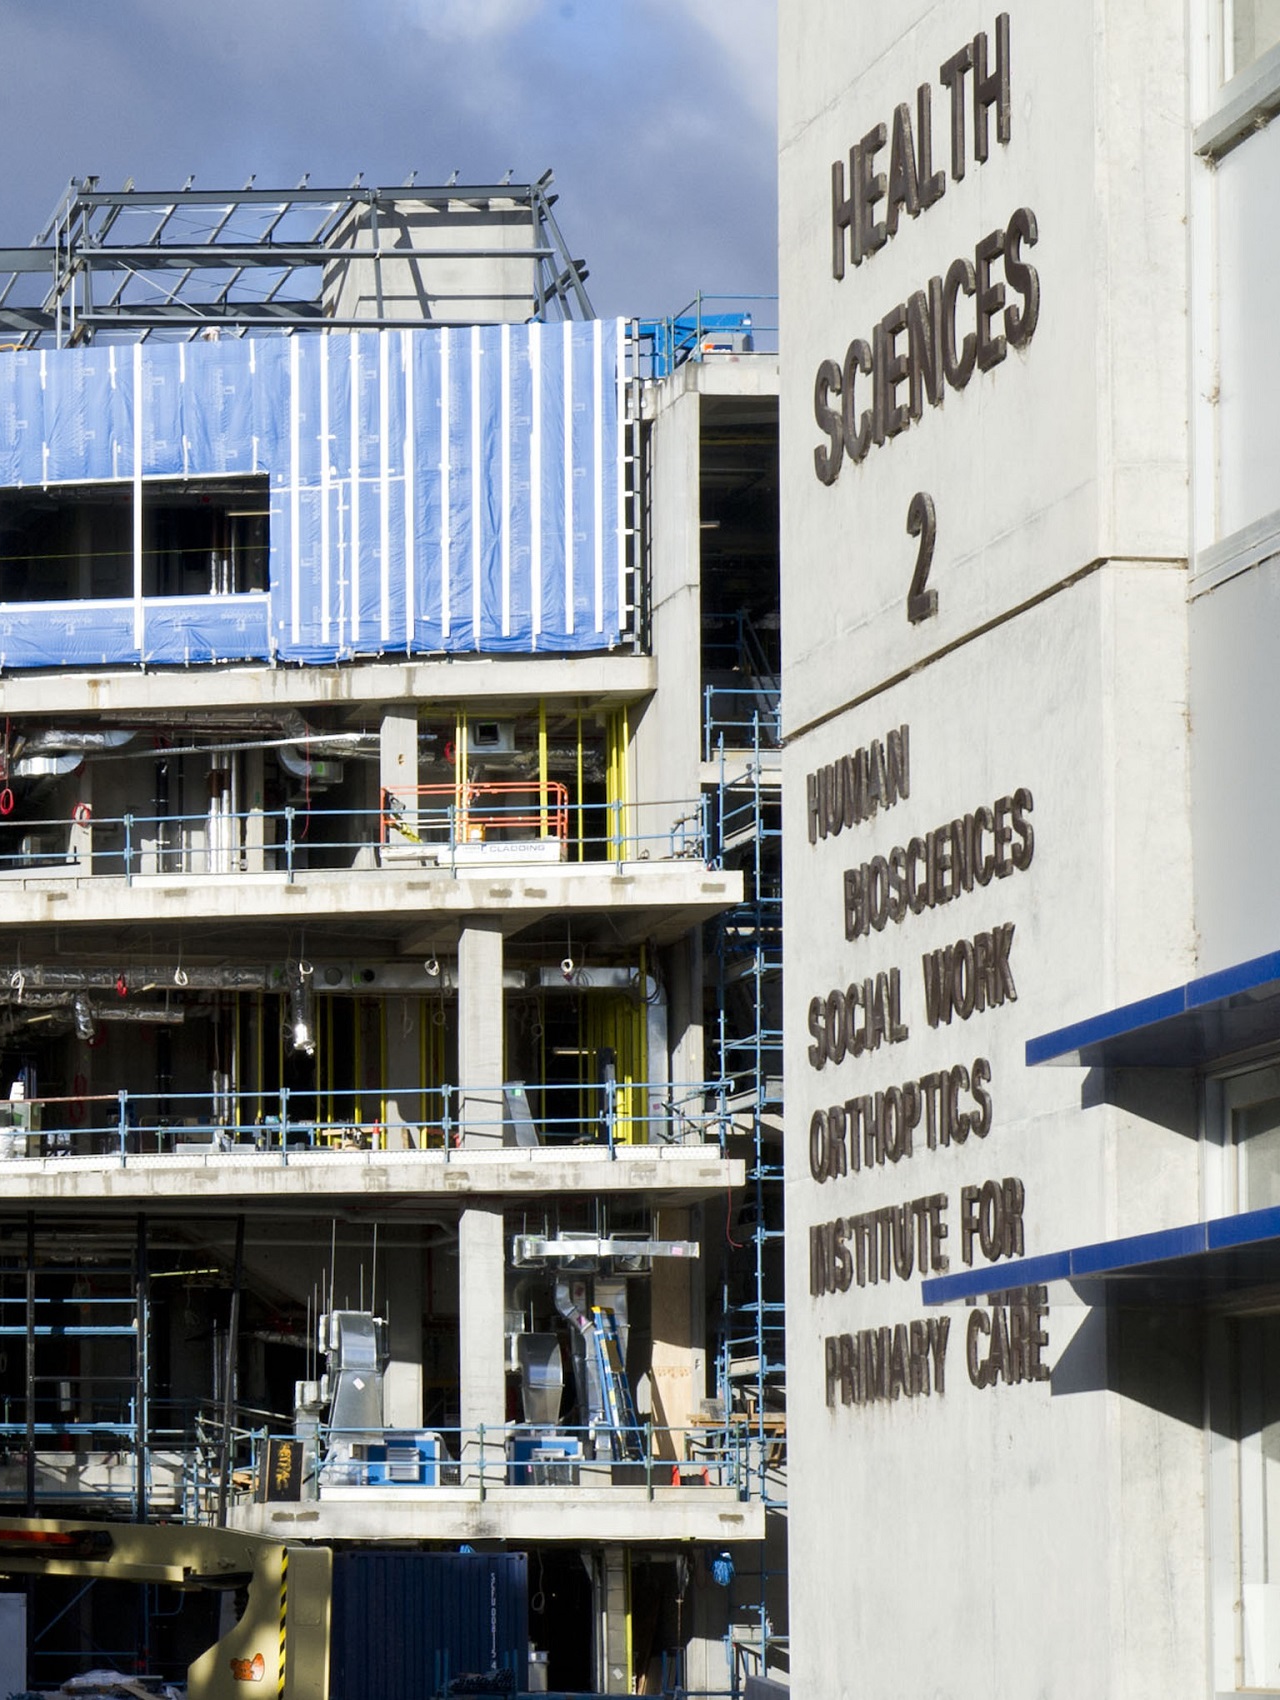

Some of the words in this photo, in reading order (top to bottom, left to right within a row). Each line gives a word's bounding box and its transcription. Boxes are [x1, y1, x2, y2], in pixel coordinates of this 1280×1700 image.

[832, 13, 1011, 281] HEALTH
[814, 208, 1040, 487] SCIENCES
[907, 492, 939, 625] 2
[489, 844, 545, 853] CLADDING
[807, 725, 910, 846] HUMAN
[843, 787, 1035, 942] BIOSCIENCES
[808, 968, 909, 1072] SOCIAL
[923, 923, 1018, 1030] WORK
[809, 1058, 993, 1185] ORTHOPTICS
[809, 1193, 950, 1298] INSTITUTE
[961, 1178, 1025, 1267] FOR
[826, 1316, 951, 1407] PRIMARY
[965, 1302, 1051, 1389] CARE
